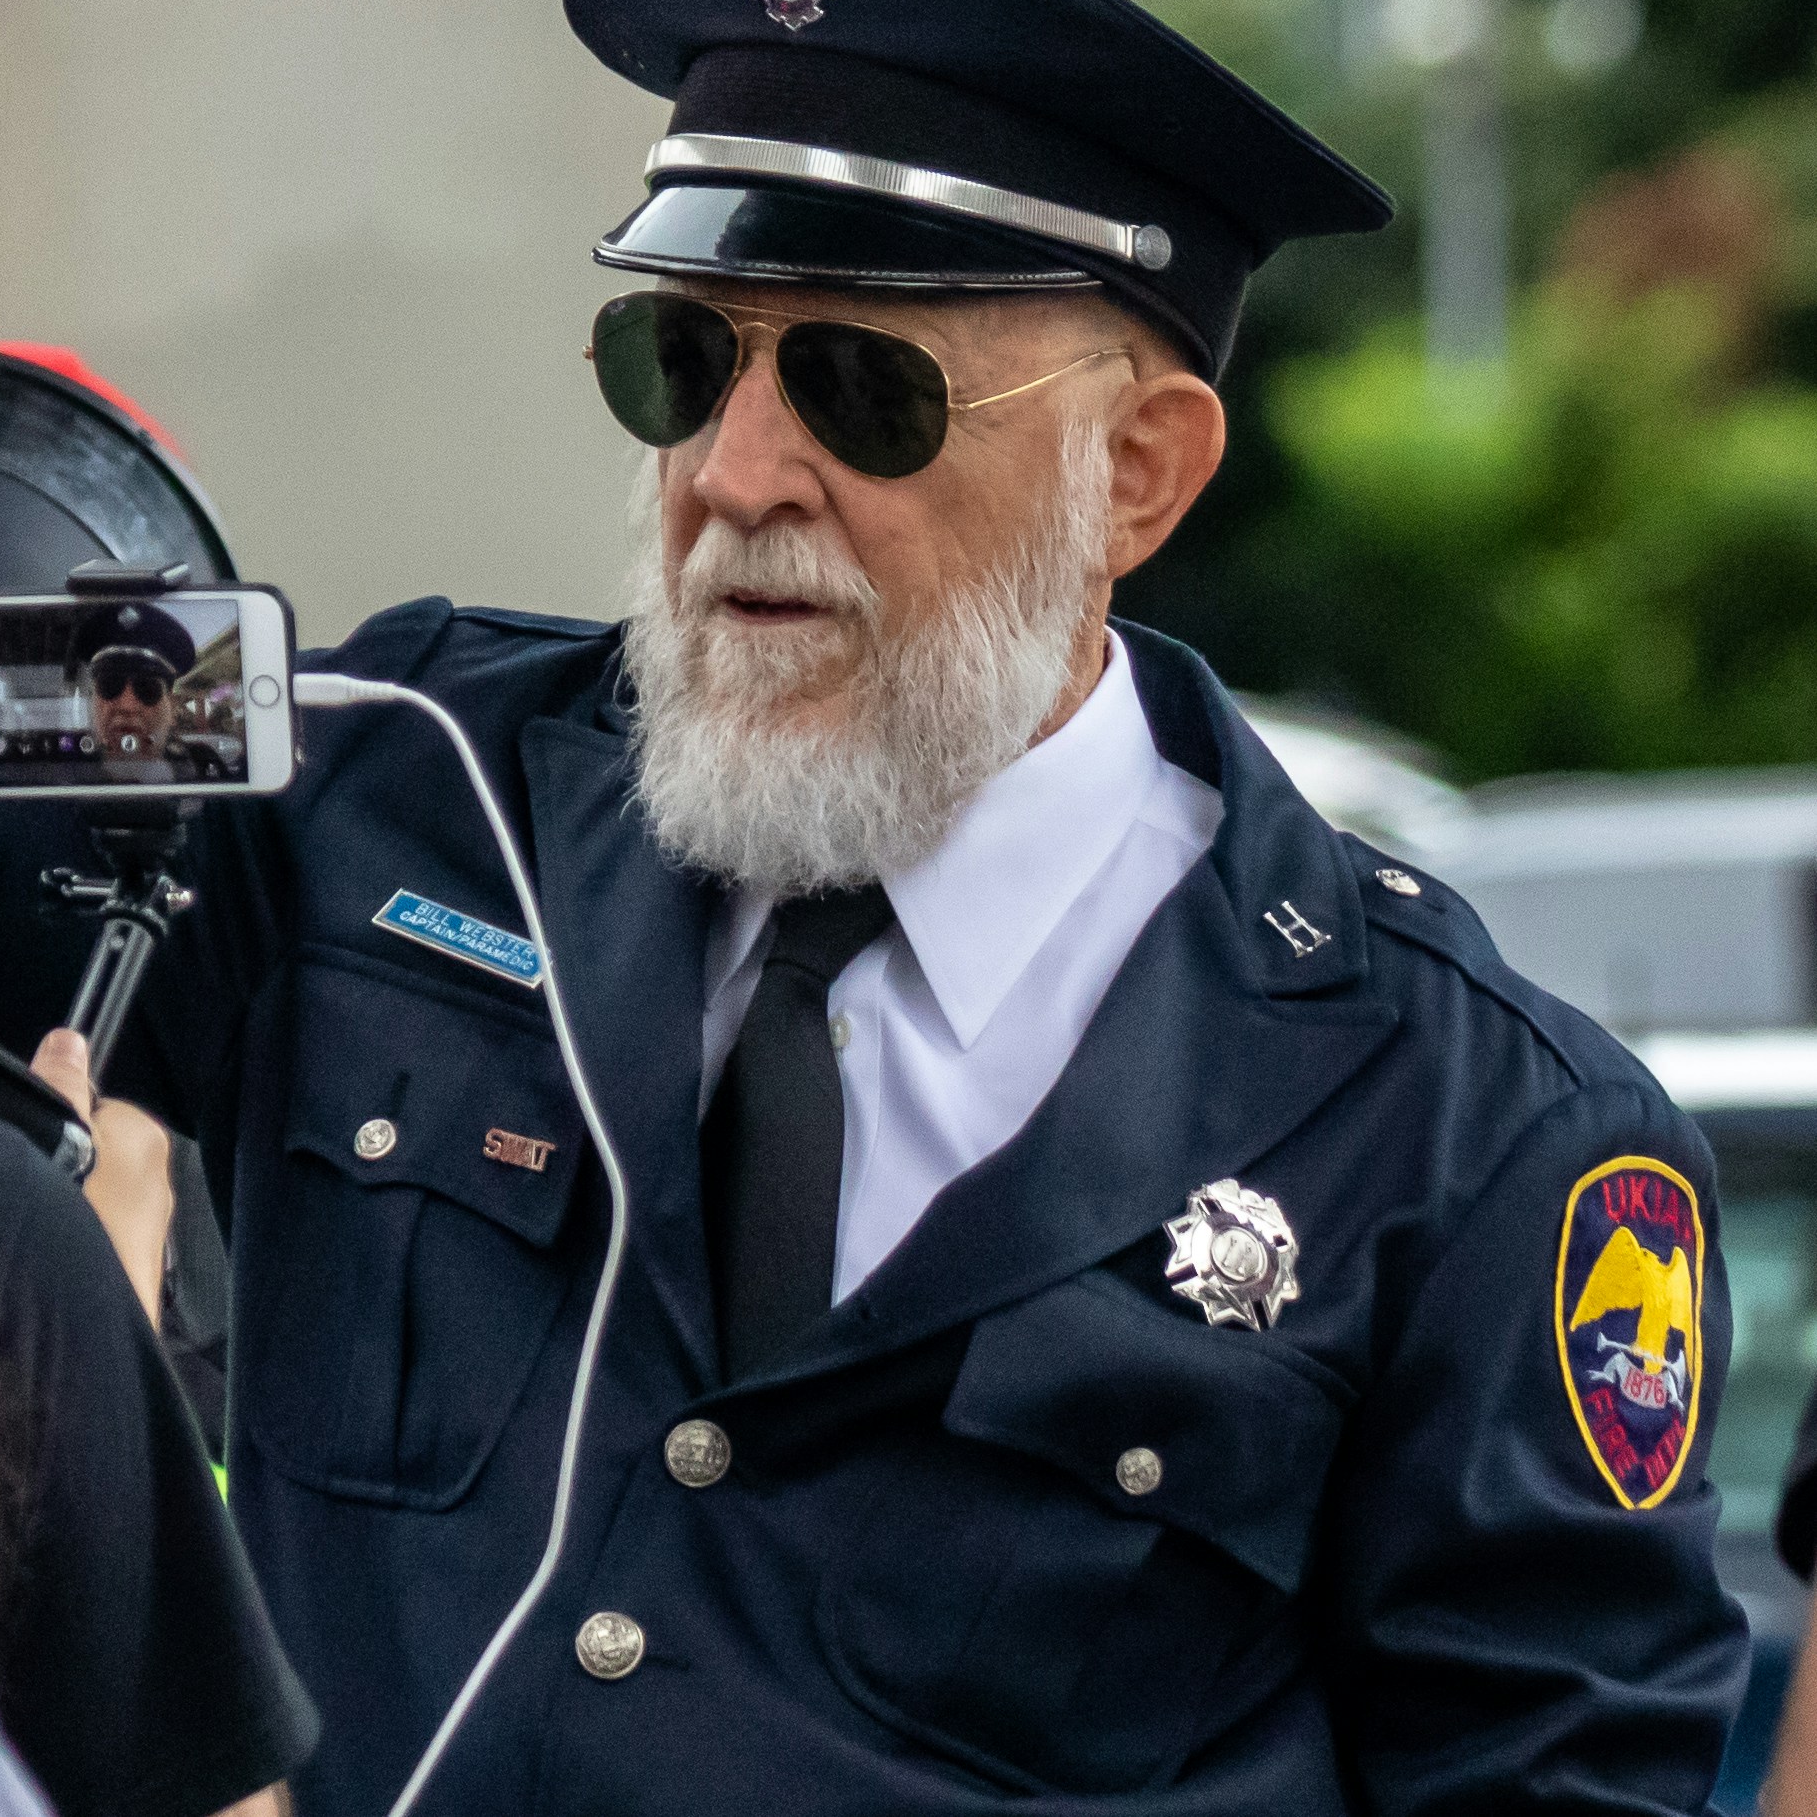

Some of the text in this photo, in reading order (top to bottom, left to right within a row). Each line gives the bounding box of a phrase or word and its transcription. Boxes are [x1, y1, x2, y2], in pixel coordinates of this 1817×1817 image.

[399, 911, 534, 972] CAPTAIN/PARAMEDIC
[415, 902, 534, 958] BILL WEBSTER
[1623, 1366, 1667, 1405] 1876
